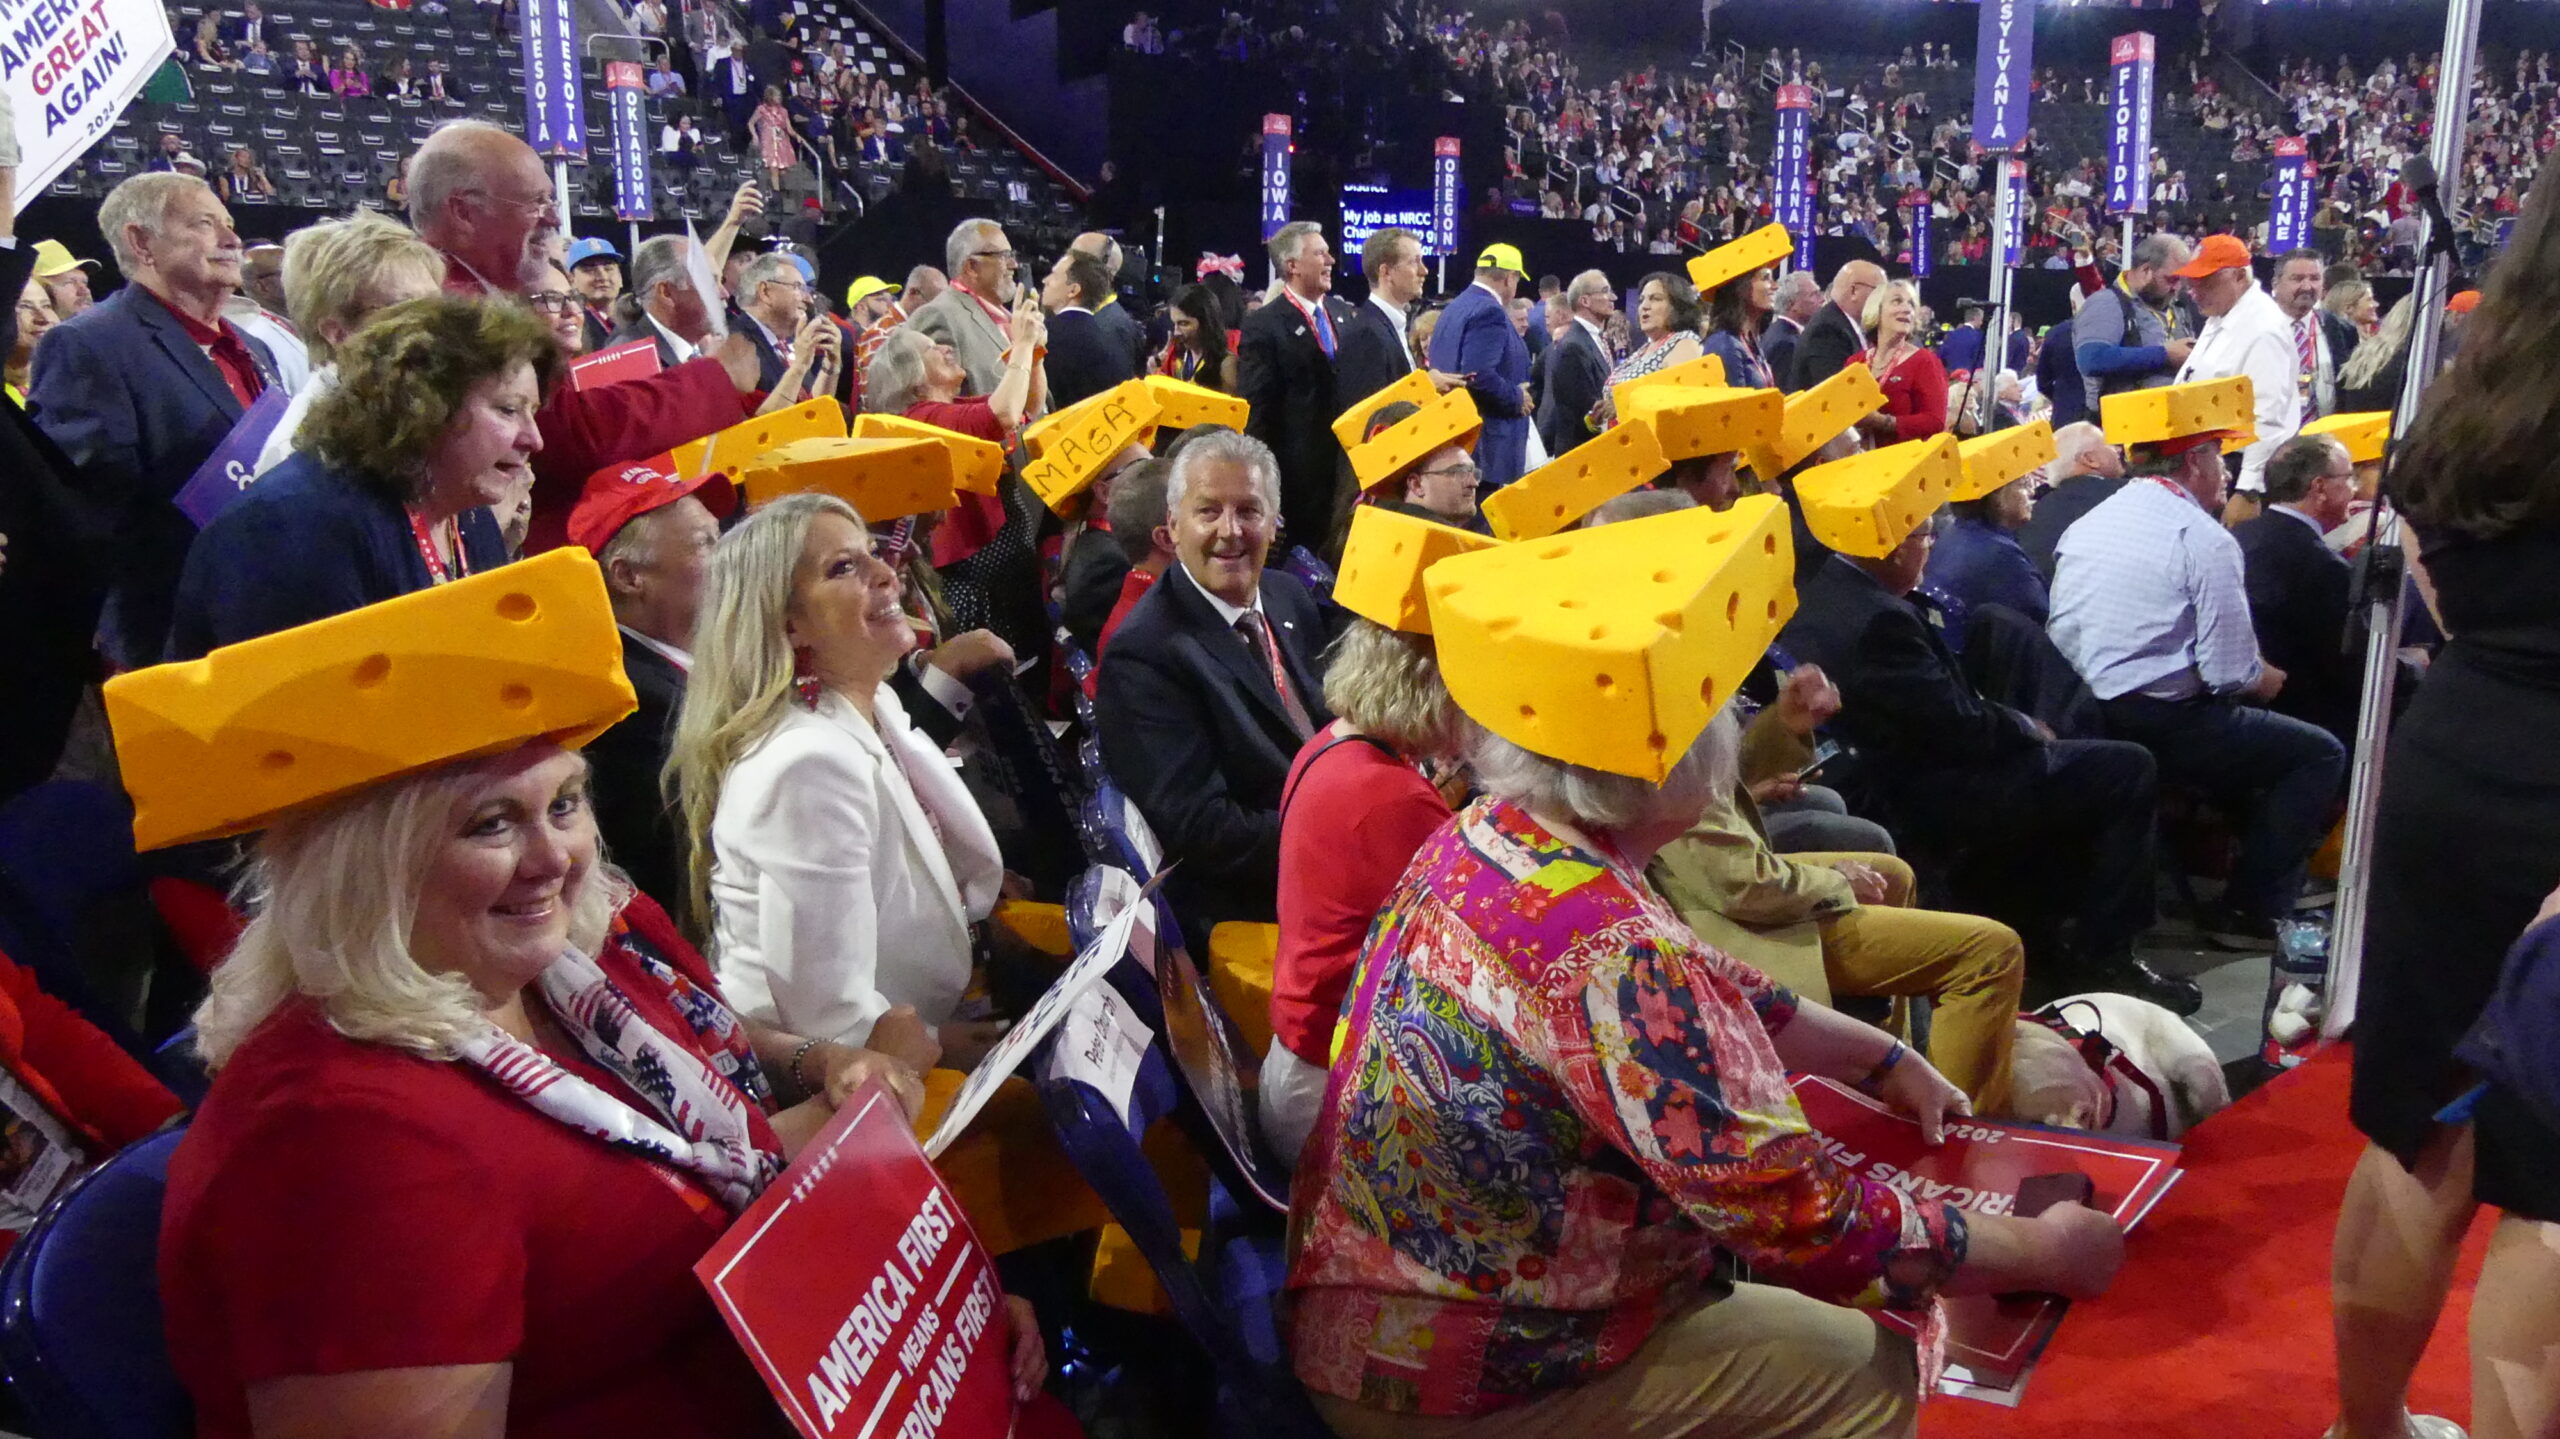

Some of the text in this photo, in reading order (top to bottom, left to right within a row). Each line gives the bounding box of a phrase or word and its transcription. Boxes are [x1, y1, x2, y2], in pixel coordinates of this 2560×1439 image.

[32, 0, 109, 96] GREAT
[46, 30, 128, 138] AGAIN!
[1991, 0, 2013, 139] SYLVANIA
[87, 101, 115, 136] 2024
[626, 91, 646, 210] OKLAHOMA
[2113, 67, 2131, 202] FLORIDA
[2136, 67, 2149, 201] FLORIDA
[1271, 152, 1288, 221] IOWA
[1443, 158, 1456, 245] OREGON
[1774, 112, 1785, 222] INDIANA
[1788, 112, 1803, 223] INDIANA
[2276, 168, 2297, 240] MAINE
[1343, 210, 1431, 226] My job as NRCC
[1343, 241, 1363, 254] the
[2004, 188, 2016, 248] GUAM
[1033, 403, 1133, 494] MAGA
[1944, 1122, 2005, 1144] 2024
[807, 1186, 955, 1432] AMERICA FIRST
[898, 1303, 941, 1377] MEANS
[954, 1265, 997, 1354] FIRST
